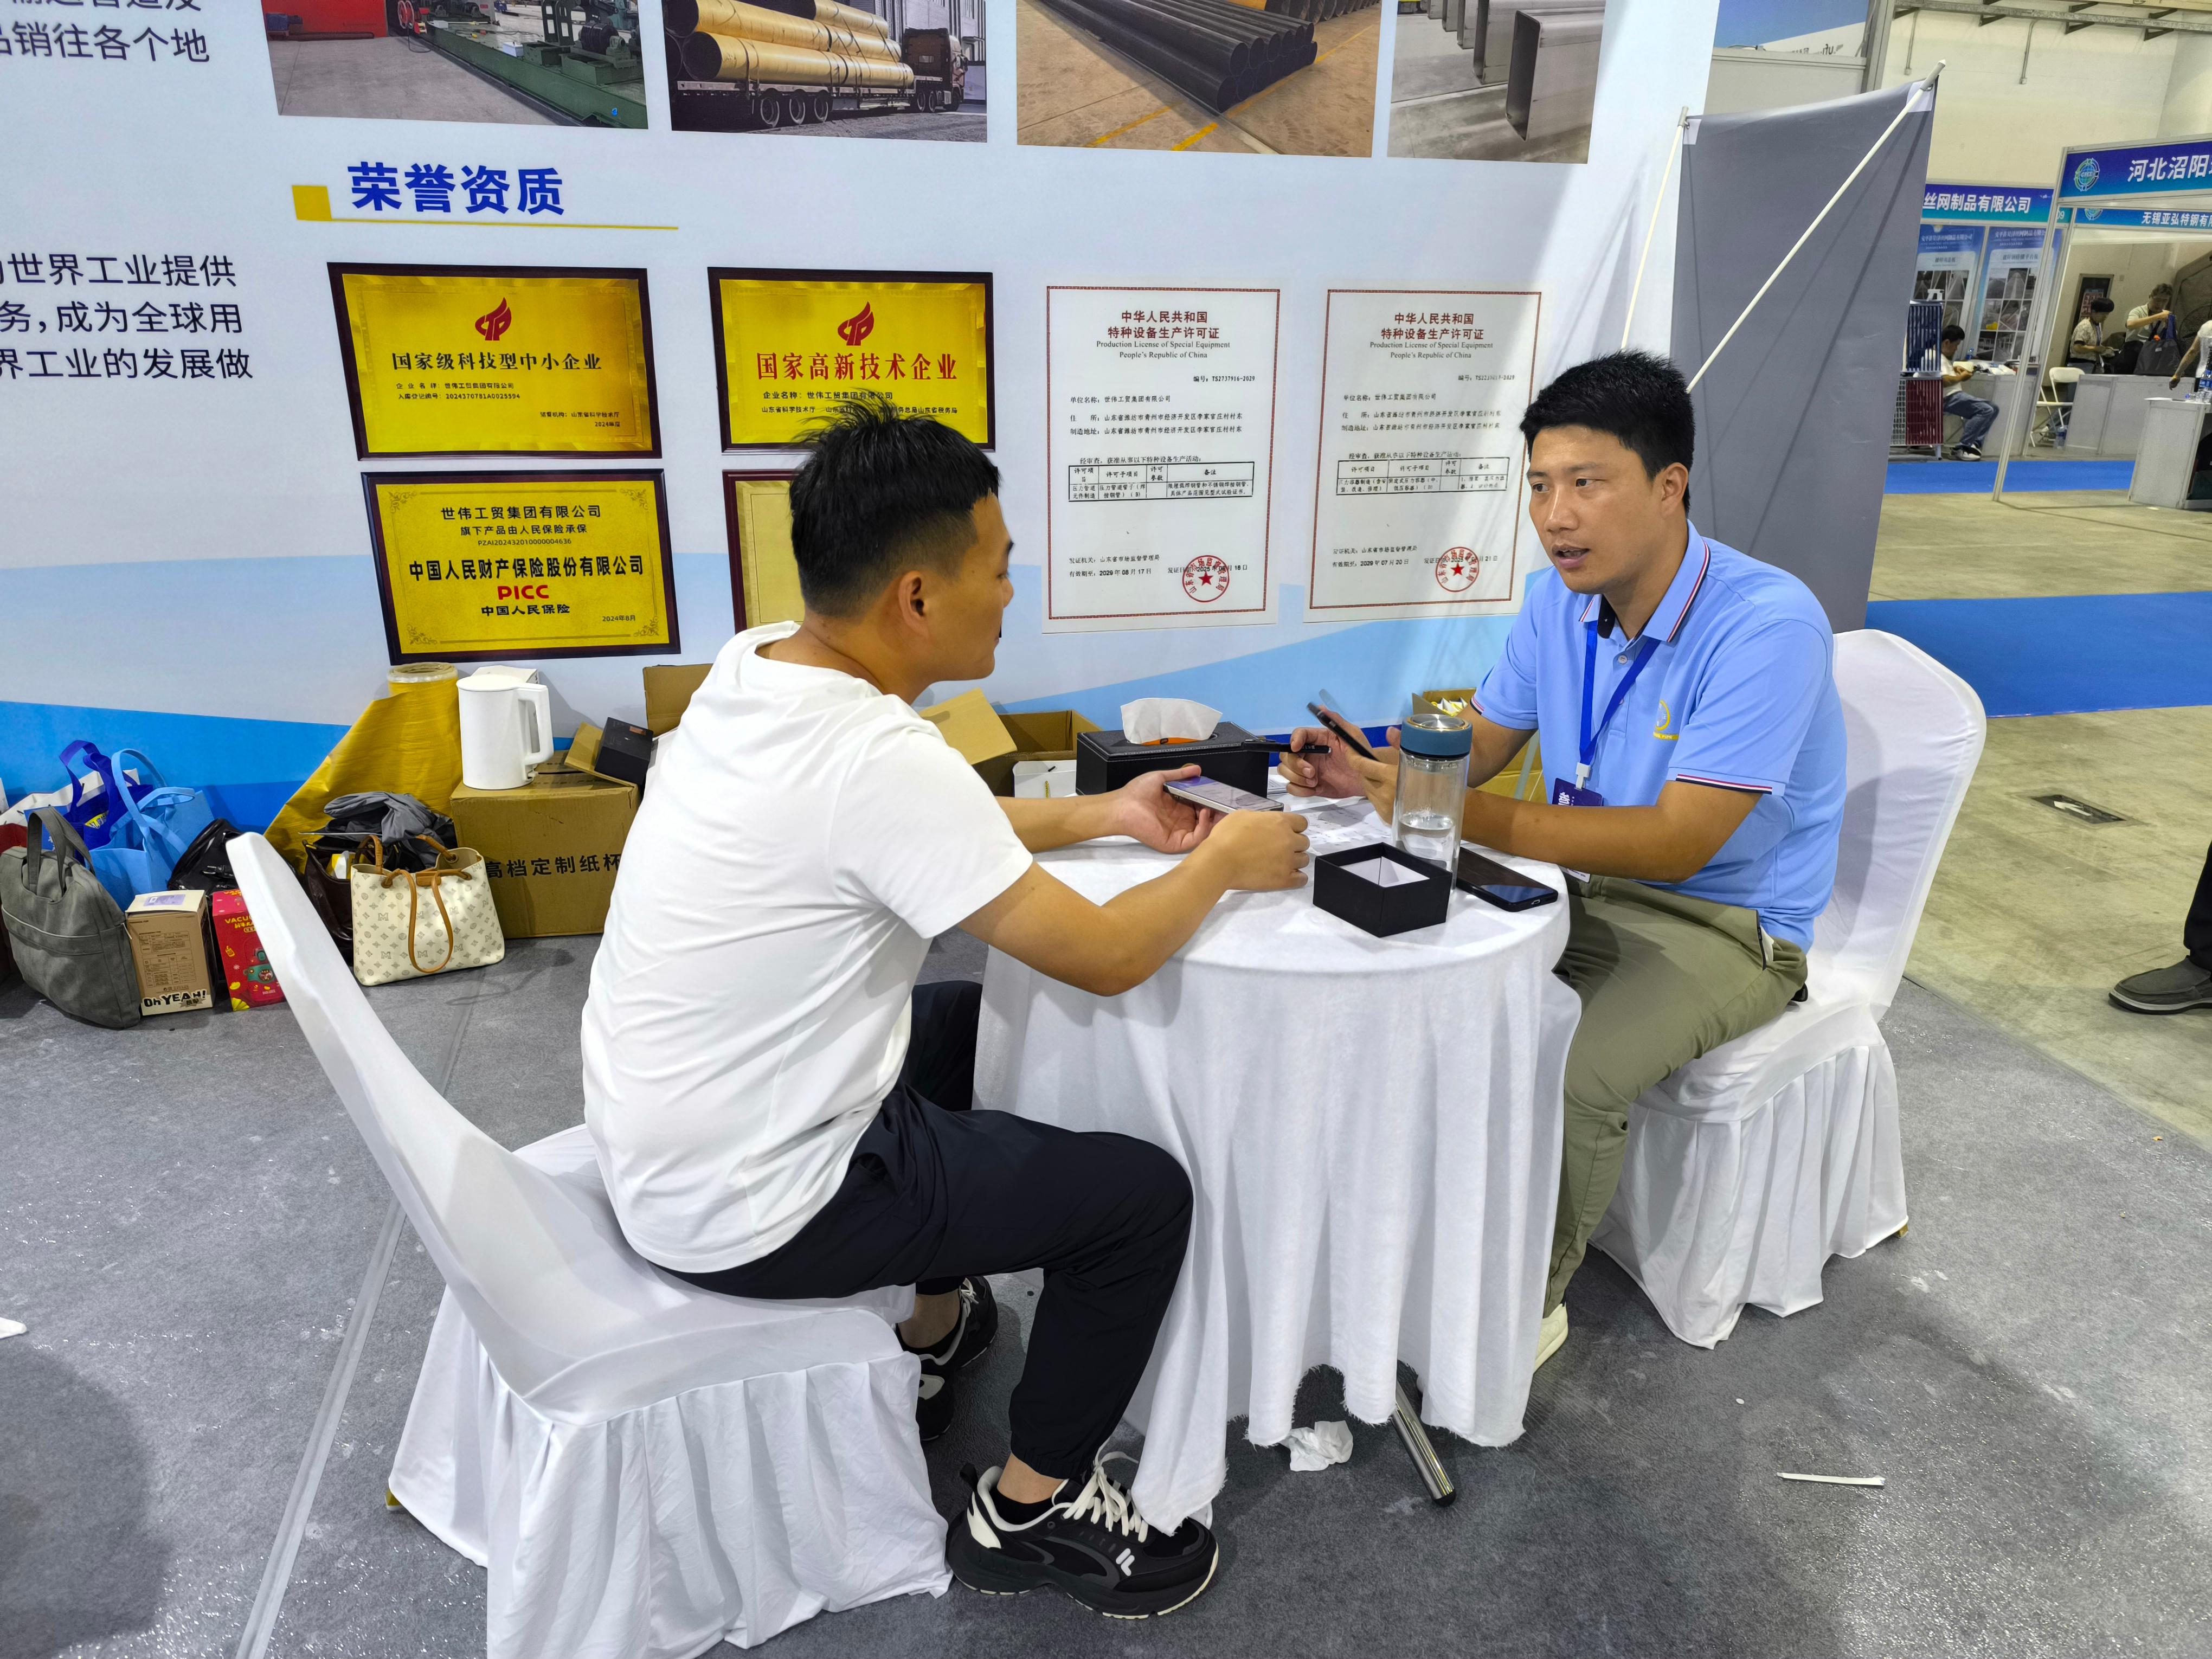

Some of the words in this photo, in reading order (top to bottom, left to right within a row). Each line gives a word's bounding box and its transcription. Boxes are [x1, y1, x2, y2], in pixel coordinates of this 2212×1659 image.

[2127, 155, 2212, 182] 河北沼阳
[347, 161, 564, 215] 荣誉资质
[1923, 192, 2031, 214] 丝网制品有限公司
[0, 252, 236, 287] 世界工业提供
[1121, 310, 1208, 323] 中华人民共和国
[1394, 312, 1474, 325] 中华人民共和国
[1108, 326, 1220, 339] 特种设备生产许可证
[1381, 327, 1484, 340] 特种设备生产许可证
[1196, 341, 1231, 349] Equipment
[1437, 342, 1459, 350] Special
[1461, 342, 1493, 350] Equipment
[392, 351, 602, 371] 国家级科技型中小企业
[1120, 351, 1147, 359] People's
[1149, 351, 1178, 359] Republic
[1418, 352, 1444, 360] Republic
[756, 351, 957, 381] 国家高新技术企业
[440, 505, 601, 520] 世伟工贸集团有限公司
[460, 524, 588, 536] 旗下产品由人民保险承保
[409, 555, 644, 582] 中国人民财产保险股份有限公司
[497, 584, 549, 601] PICC
[481, 603, 570, 617] 中国人民保险
[602, 614, 636, 623] 2024年8月
[486, 853, 622, 878] 高档定制纸杯
[224, 915, 252, 924] VACU
